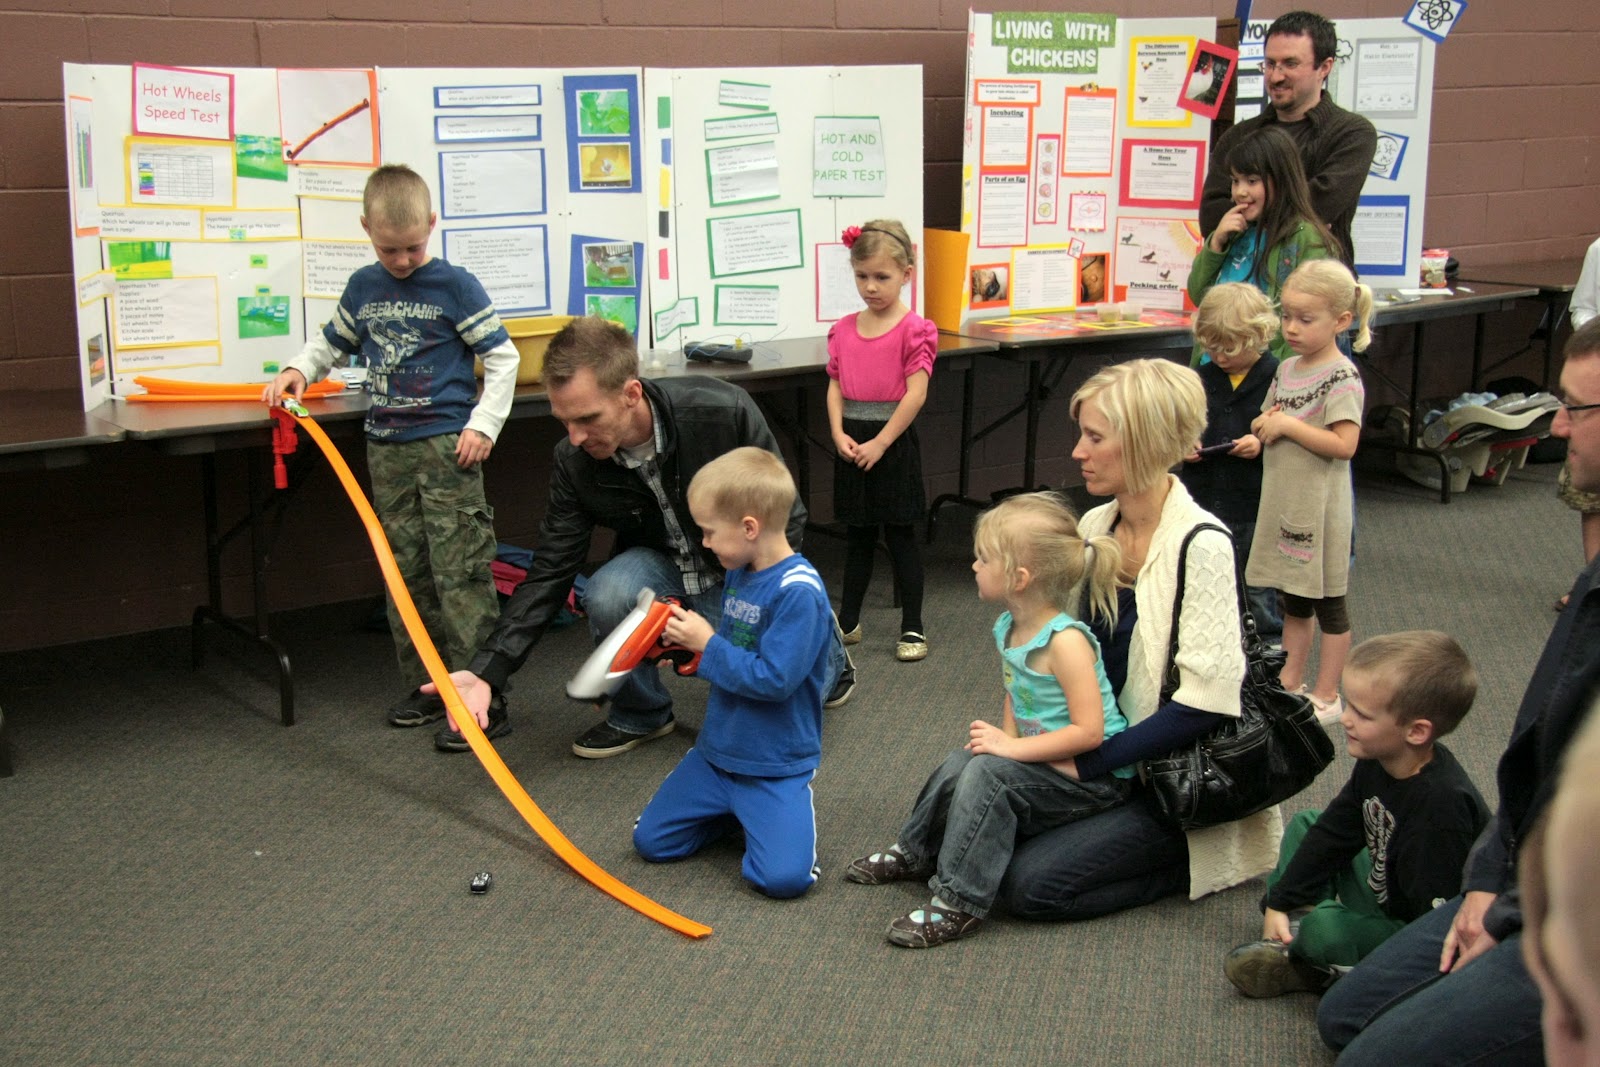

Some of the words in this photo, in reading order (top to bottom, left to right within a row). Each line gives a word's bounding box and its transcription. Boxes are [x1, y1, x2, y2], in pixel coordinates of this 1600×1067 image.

[995, 20, 1053, 40] LIVING
[1064, 21, 1111, 42] WITH
[1010, 47, 1097, 68] CHICKENS
[143, 82, 168, 98] Hot
[173, 86, 222, 103] Wheels
[144, 105, 186, 121] Speed
[191, 109, 221, 123] Test
[990, 109, 1024, 117] Incubating
[821, 133, 846, 145] HOT
[850, 134, 877, 145] AND
[831, 151, 864, 162] COLD
[814, 169, 848, 181] PAPER
[852, 170, 885, 181] TEST
[1016, 176, 1026, 184] Egg
[1130, 281, 1157, 290] Pecking
